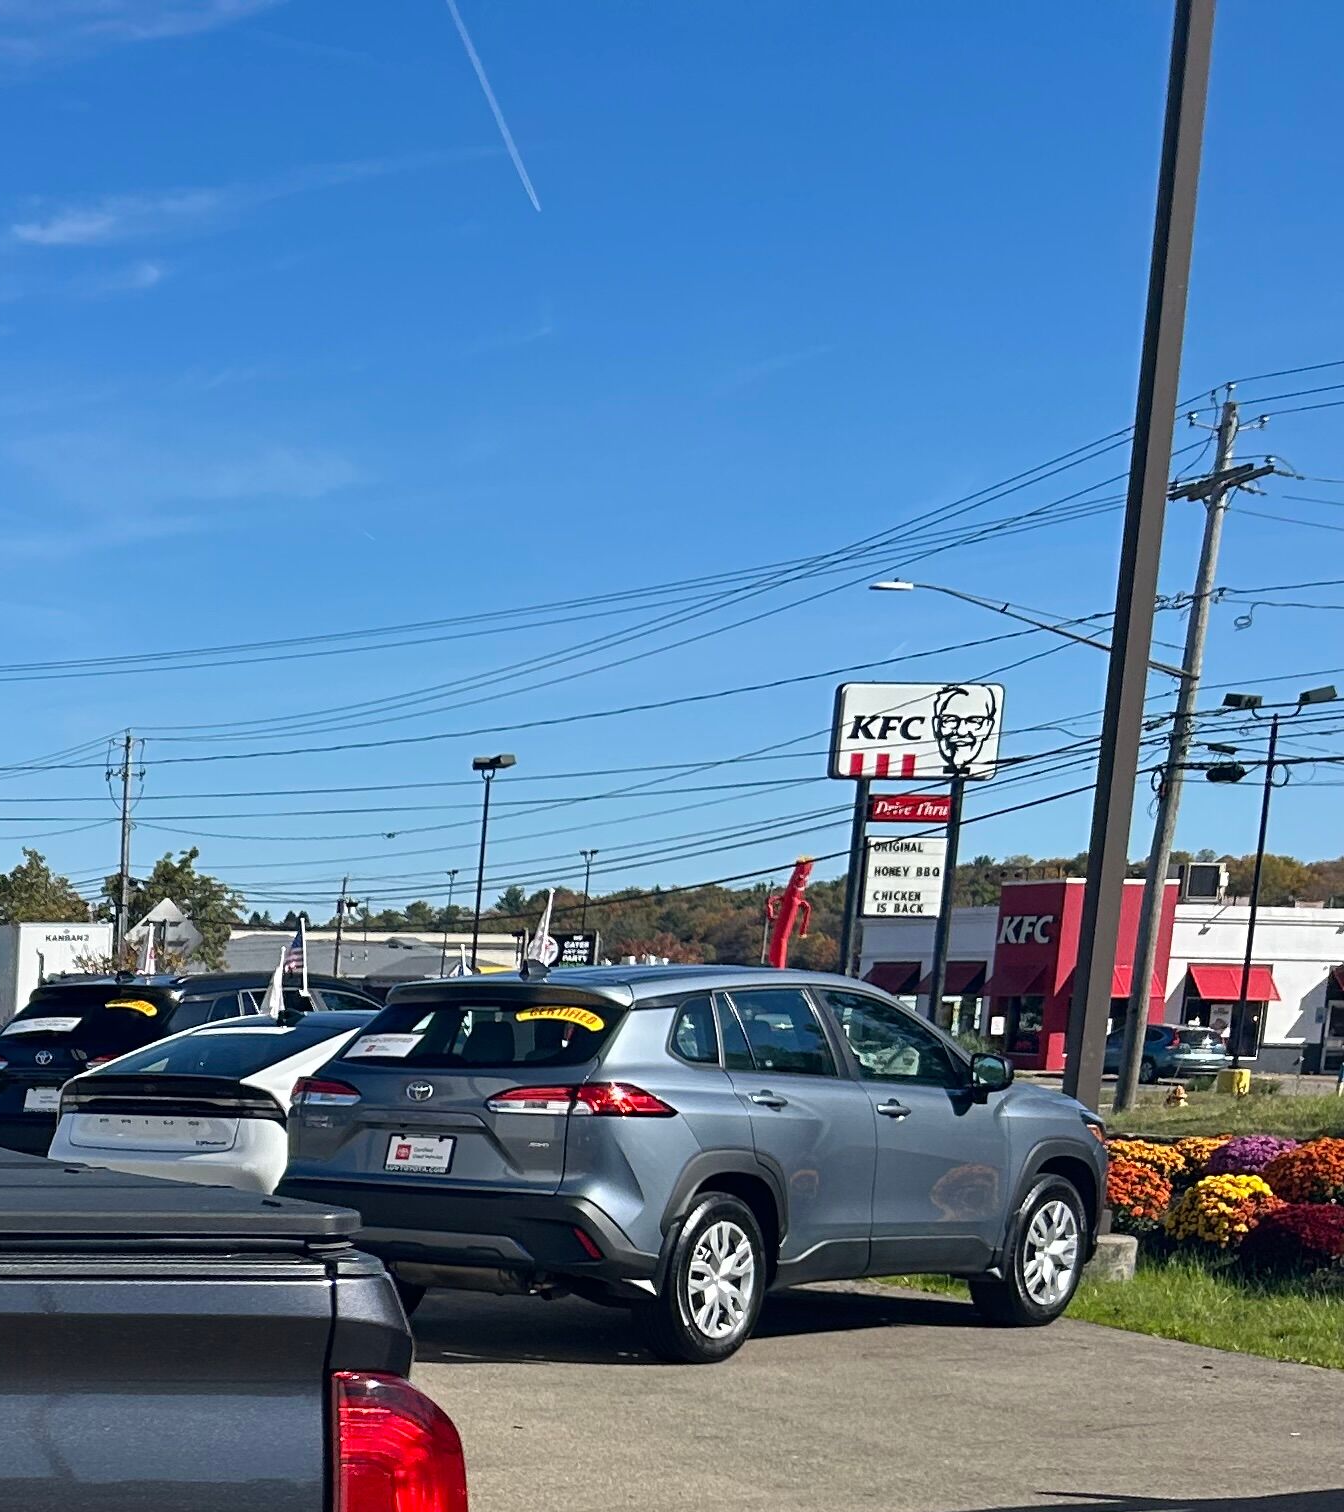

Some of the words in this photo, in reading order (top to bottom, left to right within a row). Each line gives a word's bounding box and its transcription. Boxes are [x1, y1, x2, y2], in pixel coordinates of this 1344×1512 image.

[847, 715, 925, 740] KFC
[875, 801, 912, 815] Drive
[916, 801, 948, 816] Thru
[874, 842, 923, 852] ORIGINAL
[874, 866, 910, 876] HONEY
[916, 867, 940, 877] BBQ
[873, 890, 921, 901] CHICKEN
[877, 903, 887, 913] IS
[894, 903, 923, 913] BACK
[997, 915, 1053, 944] KFC
